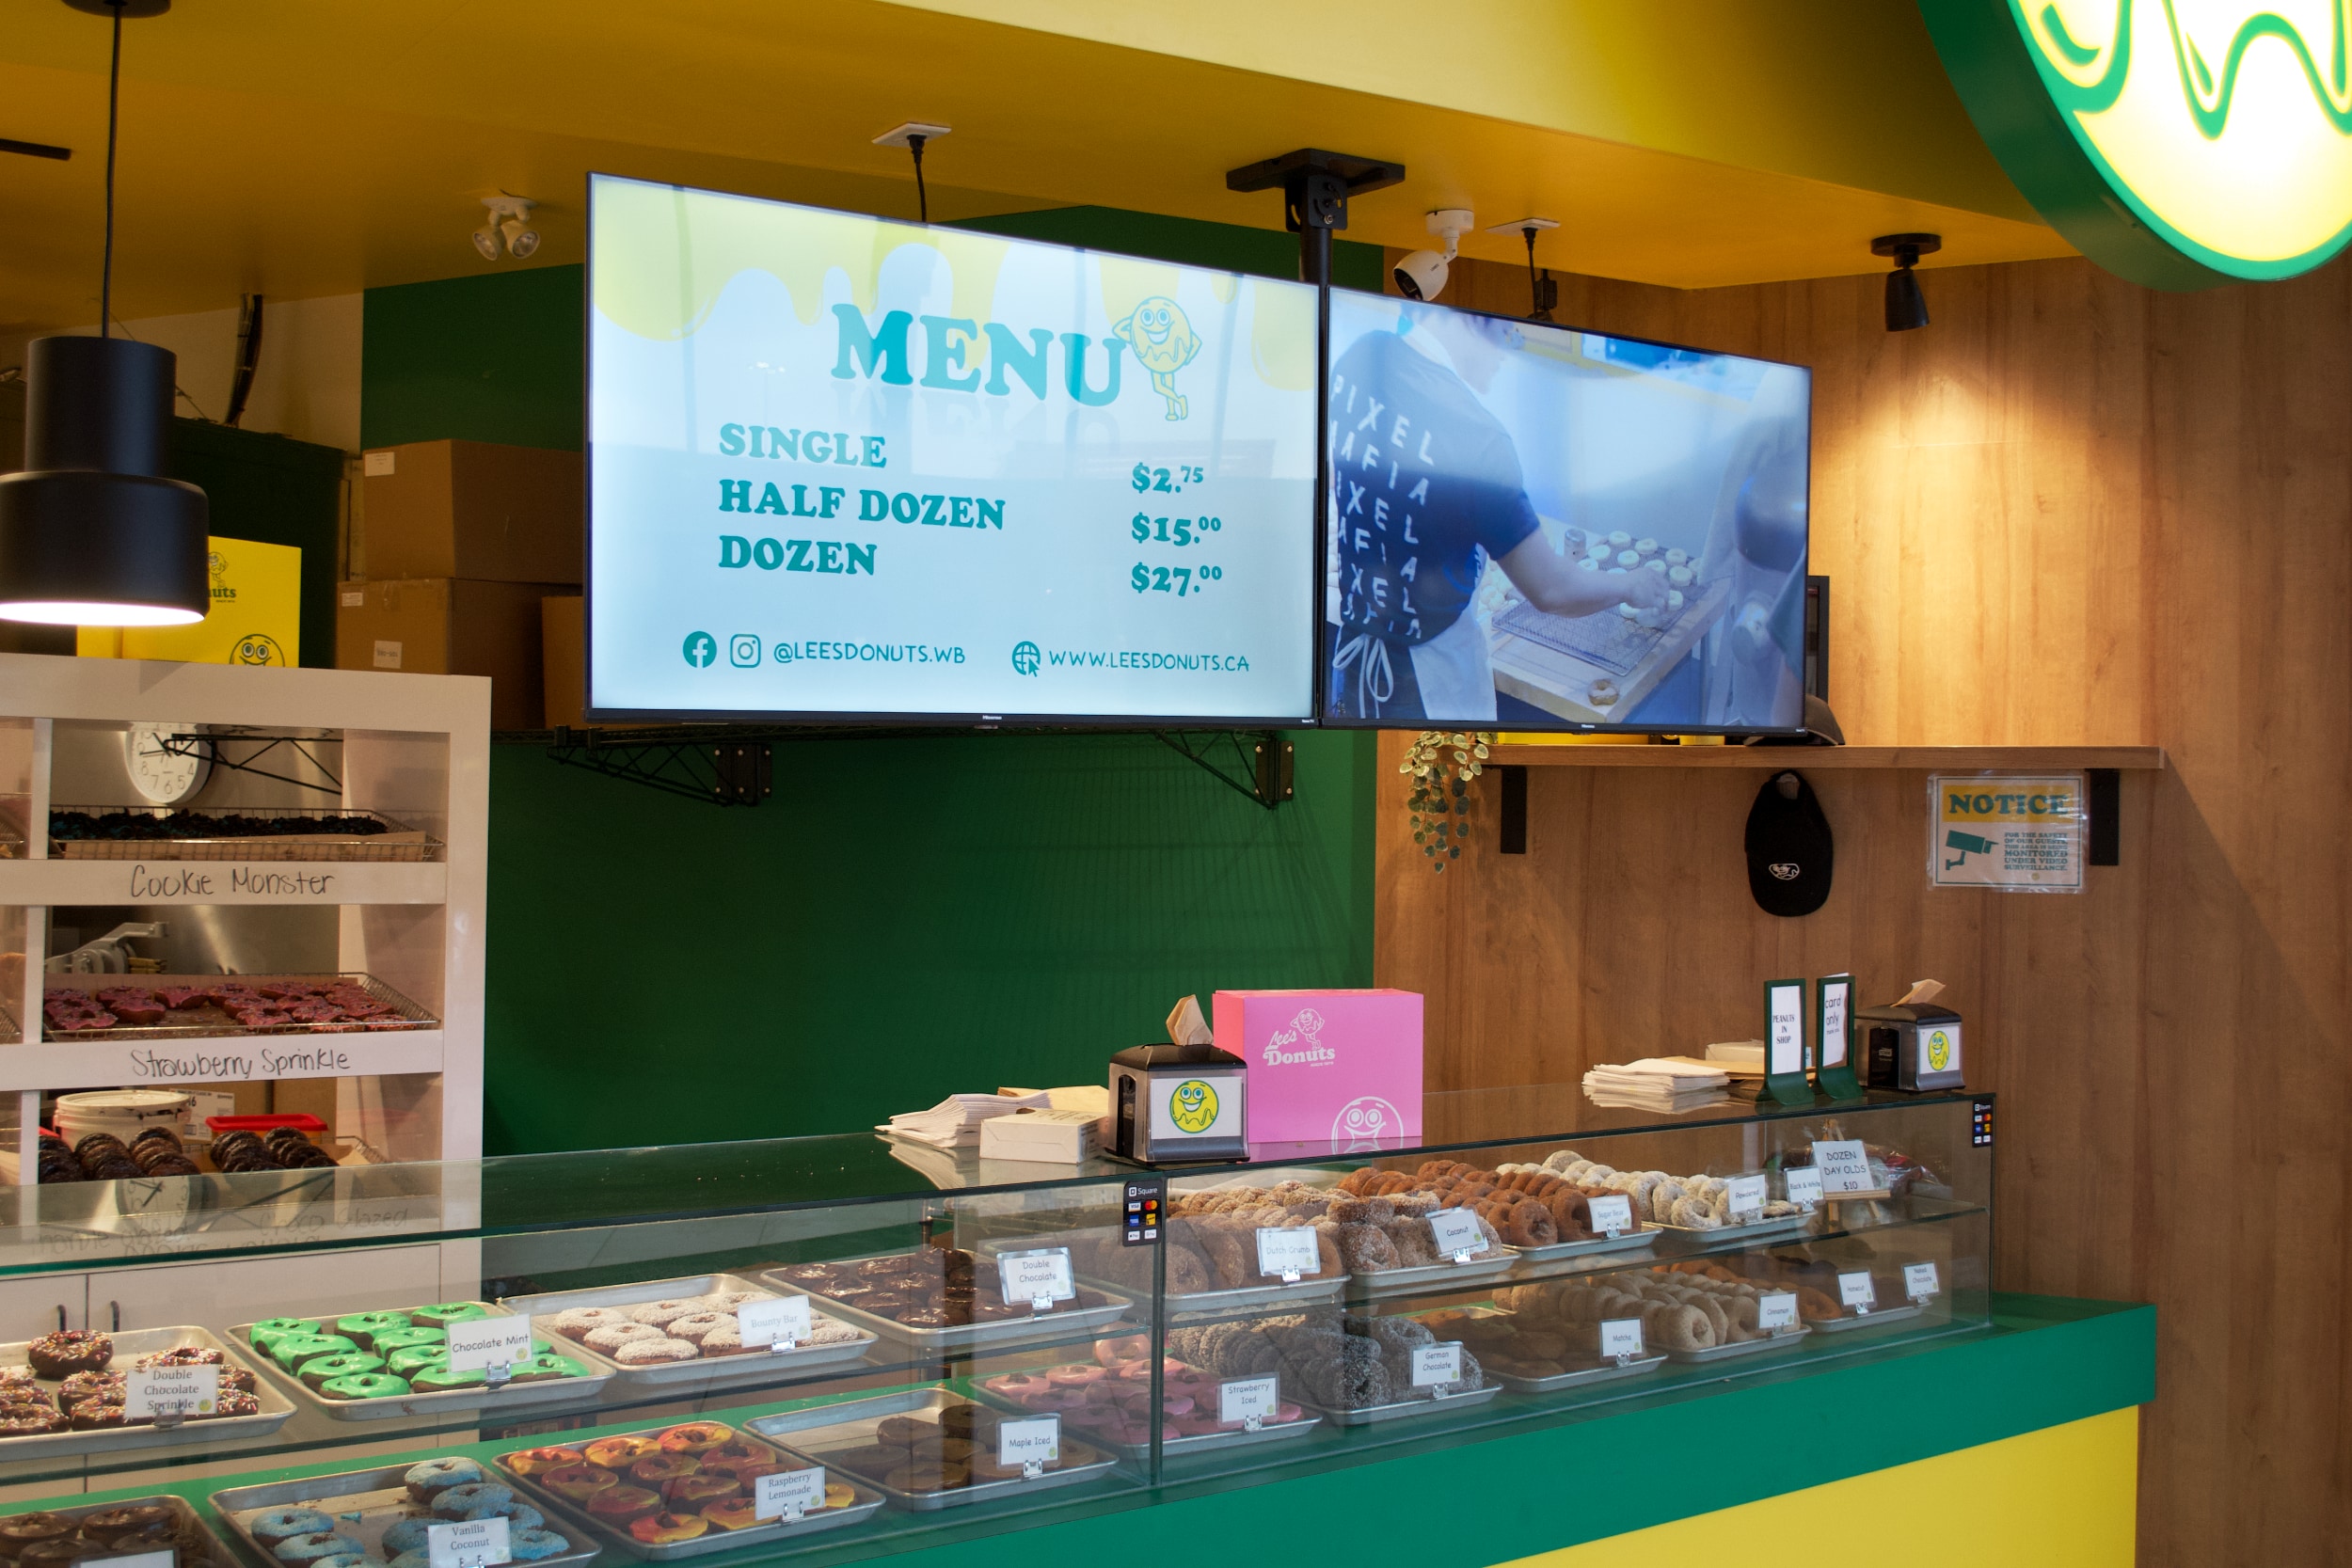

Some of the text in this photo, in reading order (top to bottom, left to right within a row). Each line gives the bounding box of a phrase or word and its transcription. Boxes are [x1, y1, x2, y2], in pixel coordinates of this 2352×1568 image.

[831, 303, 1127, 406] MENU
[1330, 374, 1435, 467] PIXEL
[719, 422, 887, 468] SINGLE
[1132, 462, 1204, 494] $2.75
[719, 479, 1006, 530] HALF DOZEN
[1132, 512, 1222, 546] $15.00
[718, 535, 877, 576] DOZEN
[1132, 562, 1223, 597] $27.00
[773, 641, 966, 664] @LEESDONUTS.WB
[1049, 650, 1249, 672] WWW.LEESDONUTS.CA
[1948, 794, 2068, 815] NOTICE
[131, 864, 335, 897] Cookie Monster
[1825, 993, 1841, 1008] card
[1772, 1014, 1795, 1023] PEANUTS
[1826, 1011, 1839, 1027] only
[1264, 1029, 1297, 1052] Lee's
[1776, 1036, 1791, 1044] SHOP
[131, 1047, 351, 1079] Strawberry Sprinkle
[1263, 1047, 1335, 1067] Donuts
[1826, 1150, 1857, 1161] DOZEN
[1824, 1165, 1867, 1176] DAY OLDS
[1137, 1187, 1158, 1196] Square
[1843, 1180, 1858, 1191] $10
[1735, 1189, 1759, 1199] Powdered
[1447, 1226, 1469, 1237] Coconut
[1266, 1244, 1311, 1255] Dutch Crumb
[1022, 1259, 1050, 1270] Double
[1019, 1272, 1057, 1283] Chocolate
[750, 1314, 798, 1328] Bounty Bar
[452, 1333, 529, 1353] Chocolate Mint
[1424, 1352, 1450, 1360] German
[1422, 1361, 1452, 1371] Chocolate
[152, 1369, 193, 1381] Double
[144, 1385, 199, 1396] Chocolate
[1228, 1383, 1270, 1394] Strawberry
[147, 1399, 195, 1413] Sprinkle
[1241, 1395, 1257, 1404] Iced
[1009, 1434, 1051, 1449] Maple Iced
[768, 1473, 812, 1488] Raspberry
[768, 1484, 812, 1500] Lemonade
[452, 1523, 485, 1536] Vanilla
[451, 1538, 490, 1550] Coconut
